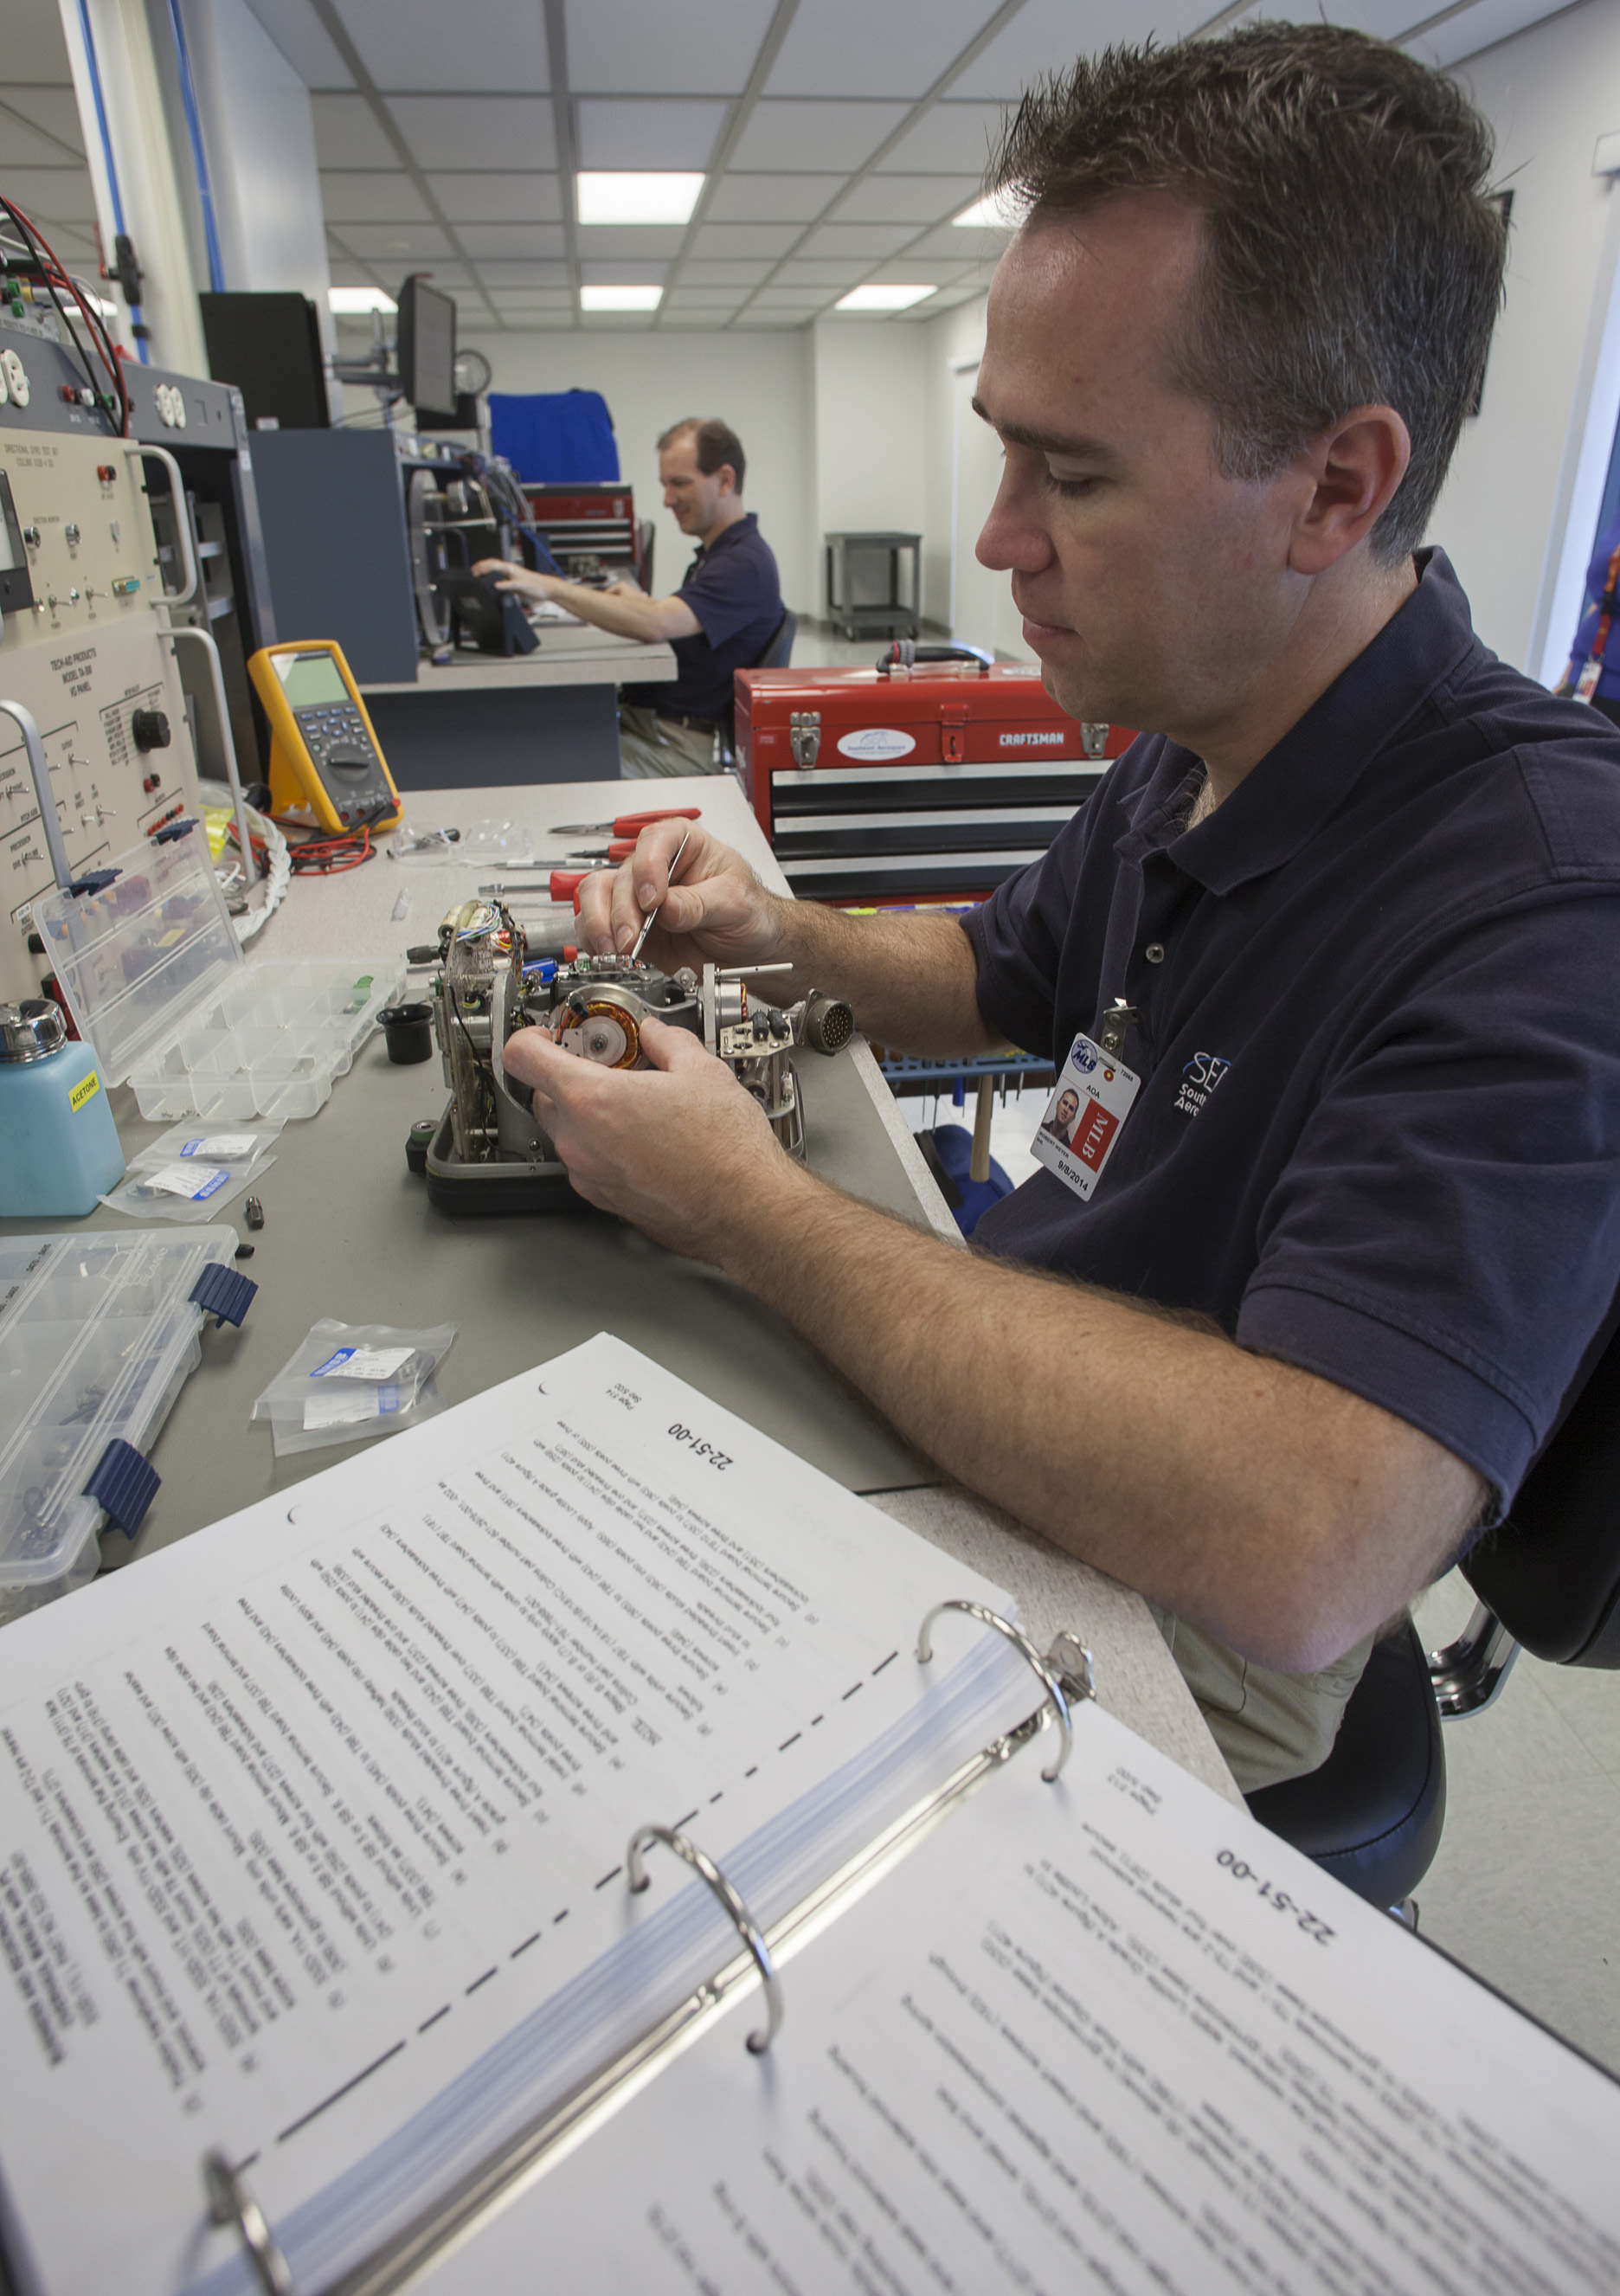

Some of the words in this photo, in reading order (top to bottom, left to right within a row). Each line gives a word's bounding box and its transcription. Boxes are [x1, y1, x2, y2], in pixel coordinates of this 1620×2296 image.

[999, 732, 1064, 747] CRAFTSMAN
[1073, 1049, 1097, 1072] MLB
[72, 1077, 98, 1106] ACETONE
[1086, 1084, 1101, 1100] AOA
[1038, 1130, 1056, 1148] ROBERT
[1055, 1142, 1070, 1159] MEYER
[1082, 1112, 1109, 1161] MLB
[1057, 1160, 1090, 1193] 9/8/2014
[663, 1422, 737, 1471] 22-51-00
[1210, 1847, 1340, 1947] 22-51-00
